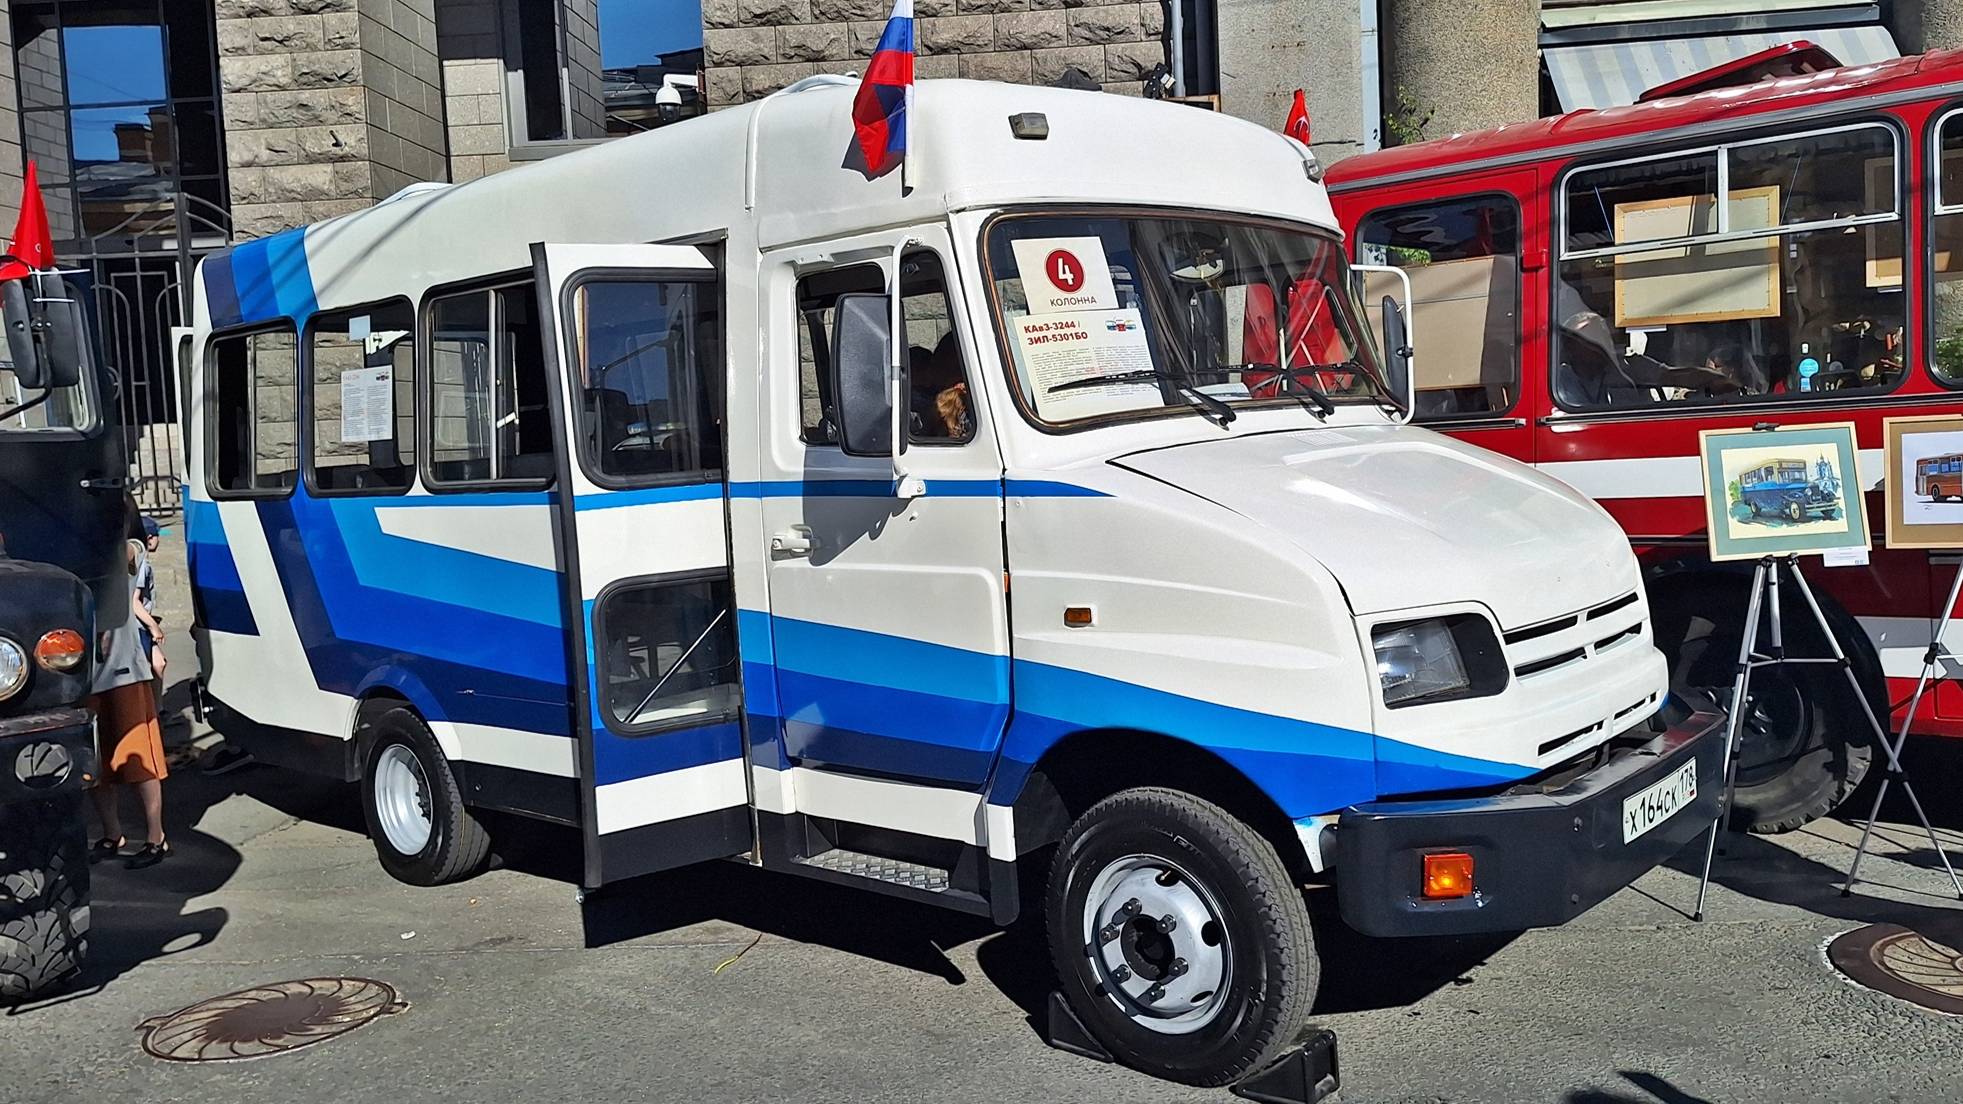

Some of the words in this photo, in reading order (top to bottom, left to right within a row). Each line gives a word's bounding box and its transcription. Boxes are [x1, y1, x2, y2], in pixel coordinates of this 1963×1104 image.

[1057, 257, 1074, 286] 4
[1050, 296, 1097, 308] КОЛОННА
[1024, 321, 1076, 334] КАвЗ-3244
[1027, 331, 1088, 345] ЗИЛ-5301БО
